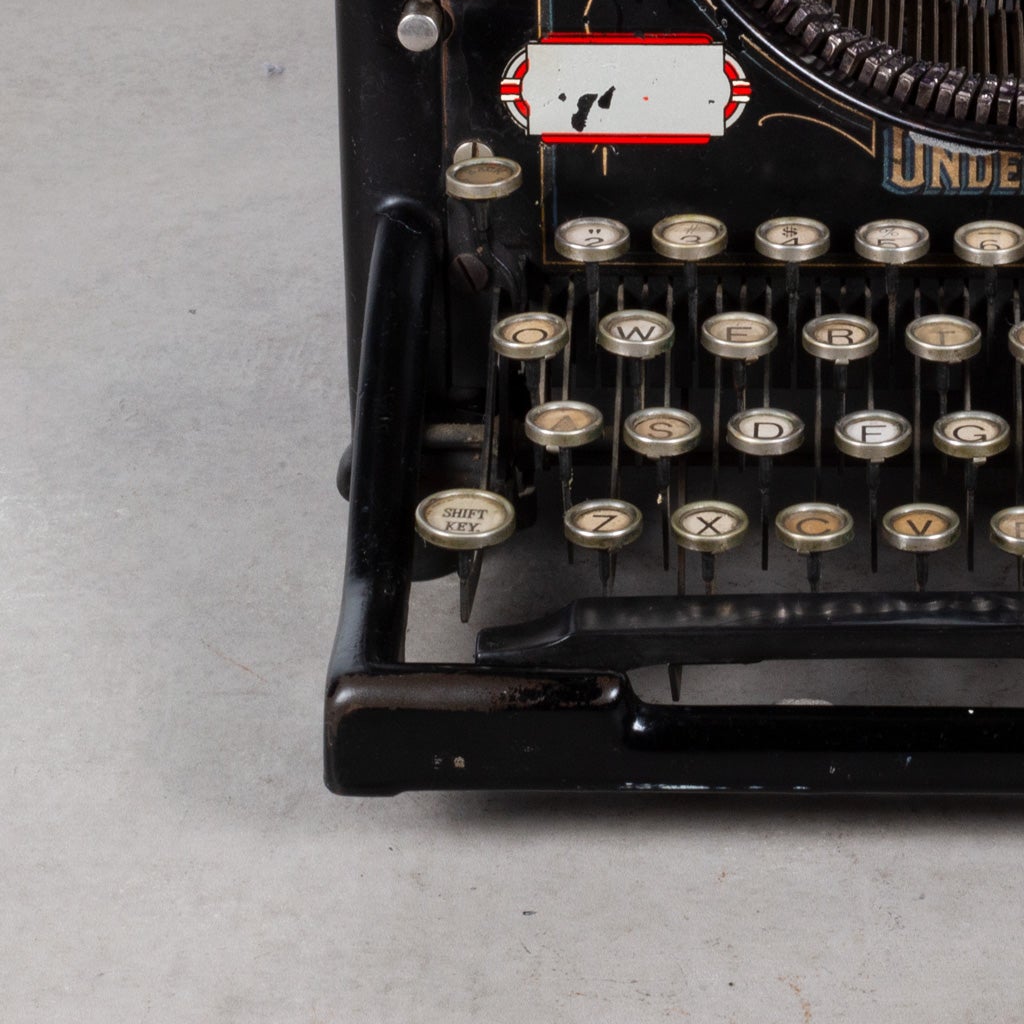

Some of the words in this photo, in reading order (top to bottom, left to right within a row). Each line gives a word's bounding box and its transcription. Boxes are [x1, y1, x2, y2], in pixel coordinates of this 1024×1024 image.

[616, 326, 657, 342] W
[827, 328, 854, 345] R
[647, 420, 674, 439] S
[753, 422, 784, 440] D
[861, 424, 887, 443] F
[952, 424, 987, 443] G
[442, 507, 489, 519] SHIFT
[695, 517, 723, 535] X
[796, 517, 830, 536] C
[906, 519, 933, 536] V
